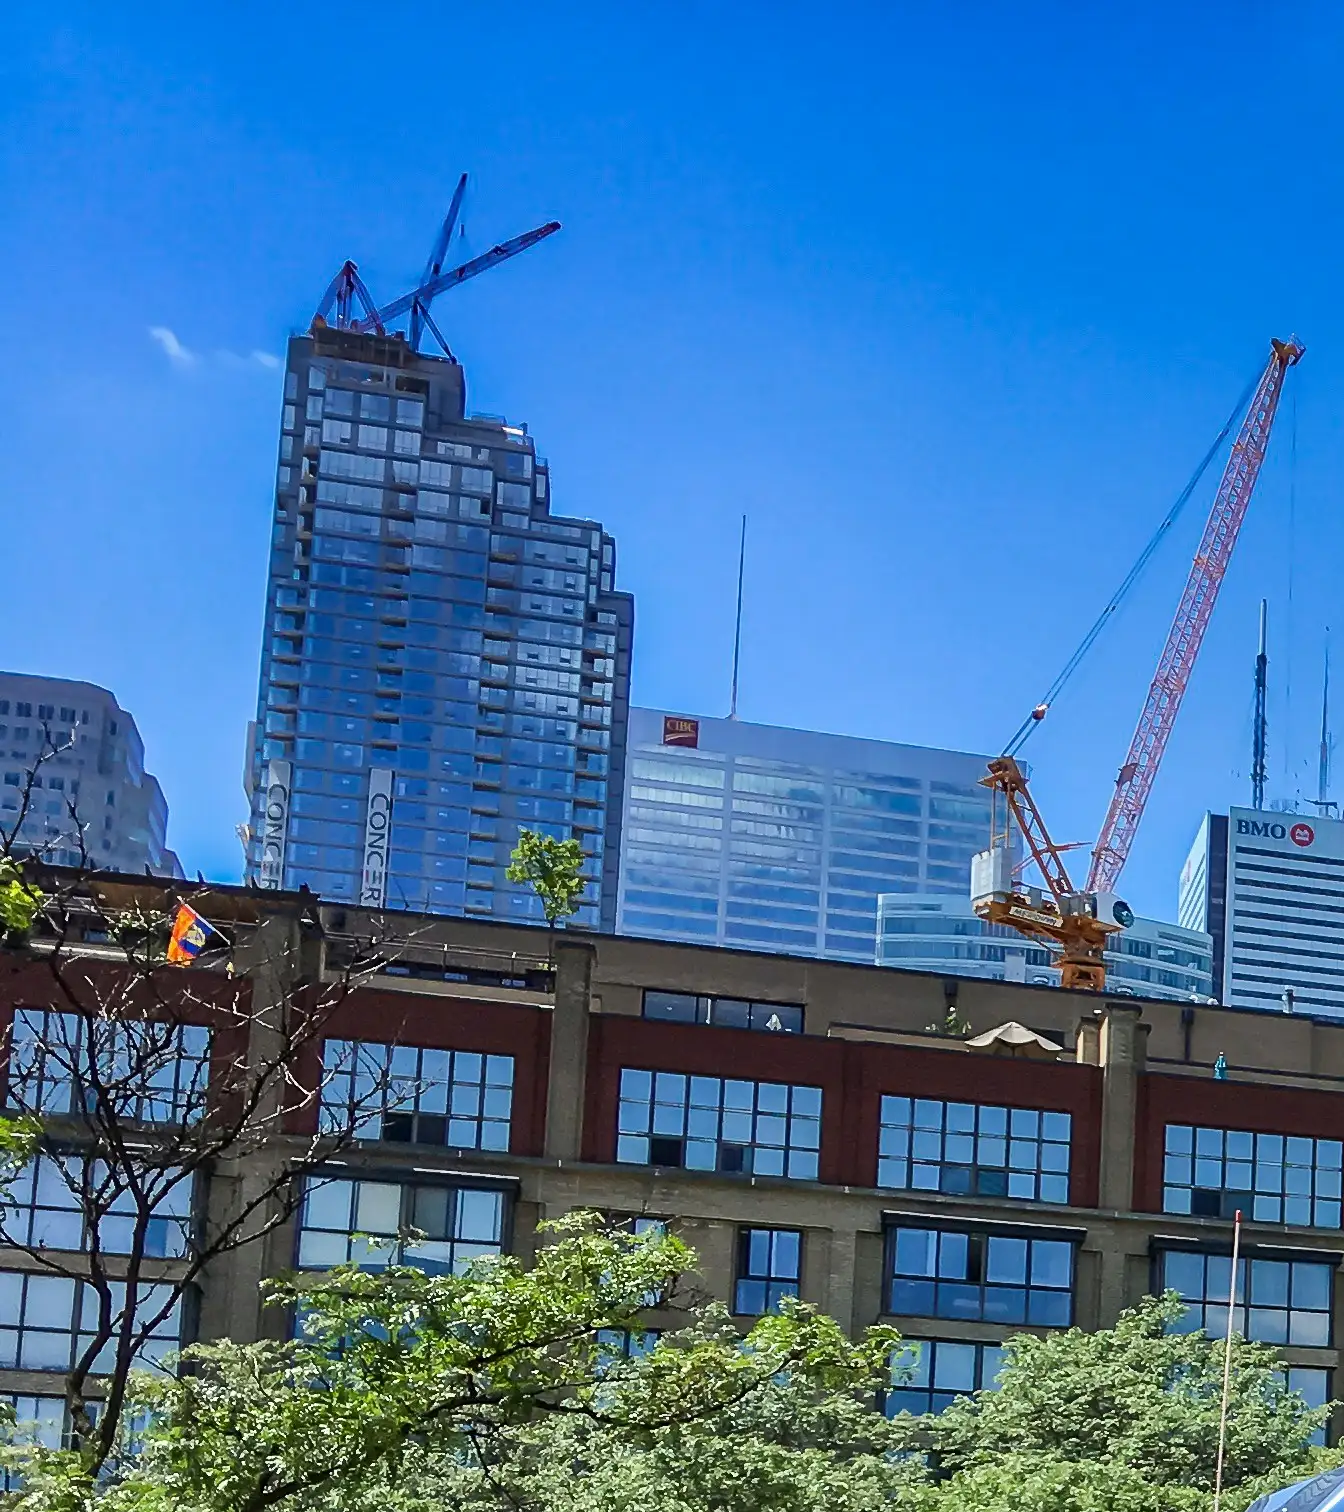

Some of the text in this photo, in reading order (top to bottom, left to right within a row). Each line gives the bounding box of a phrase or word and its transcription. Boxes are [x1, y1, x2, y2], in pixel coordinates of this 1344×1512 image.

[665, 719, 697, 733] CIBC
[261, 783, 288, 890] CONCER
[362, 792, 391, 906] CONCER
[1236, 819, 1287, 840] BMO
